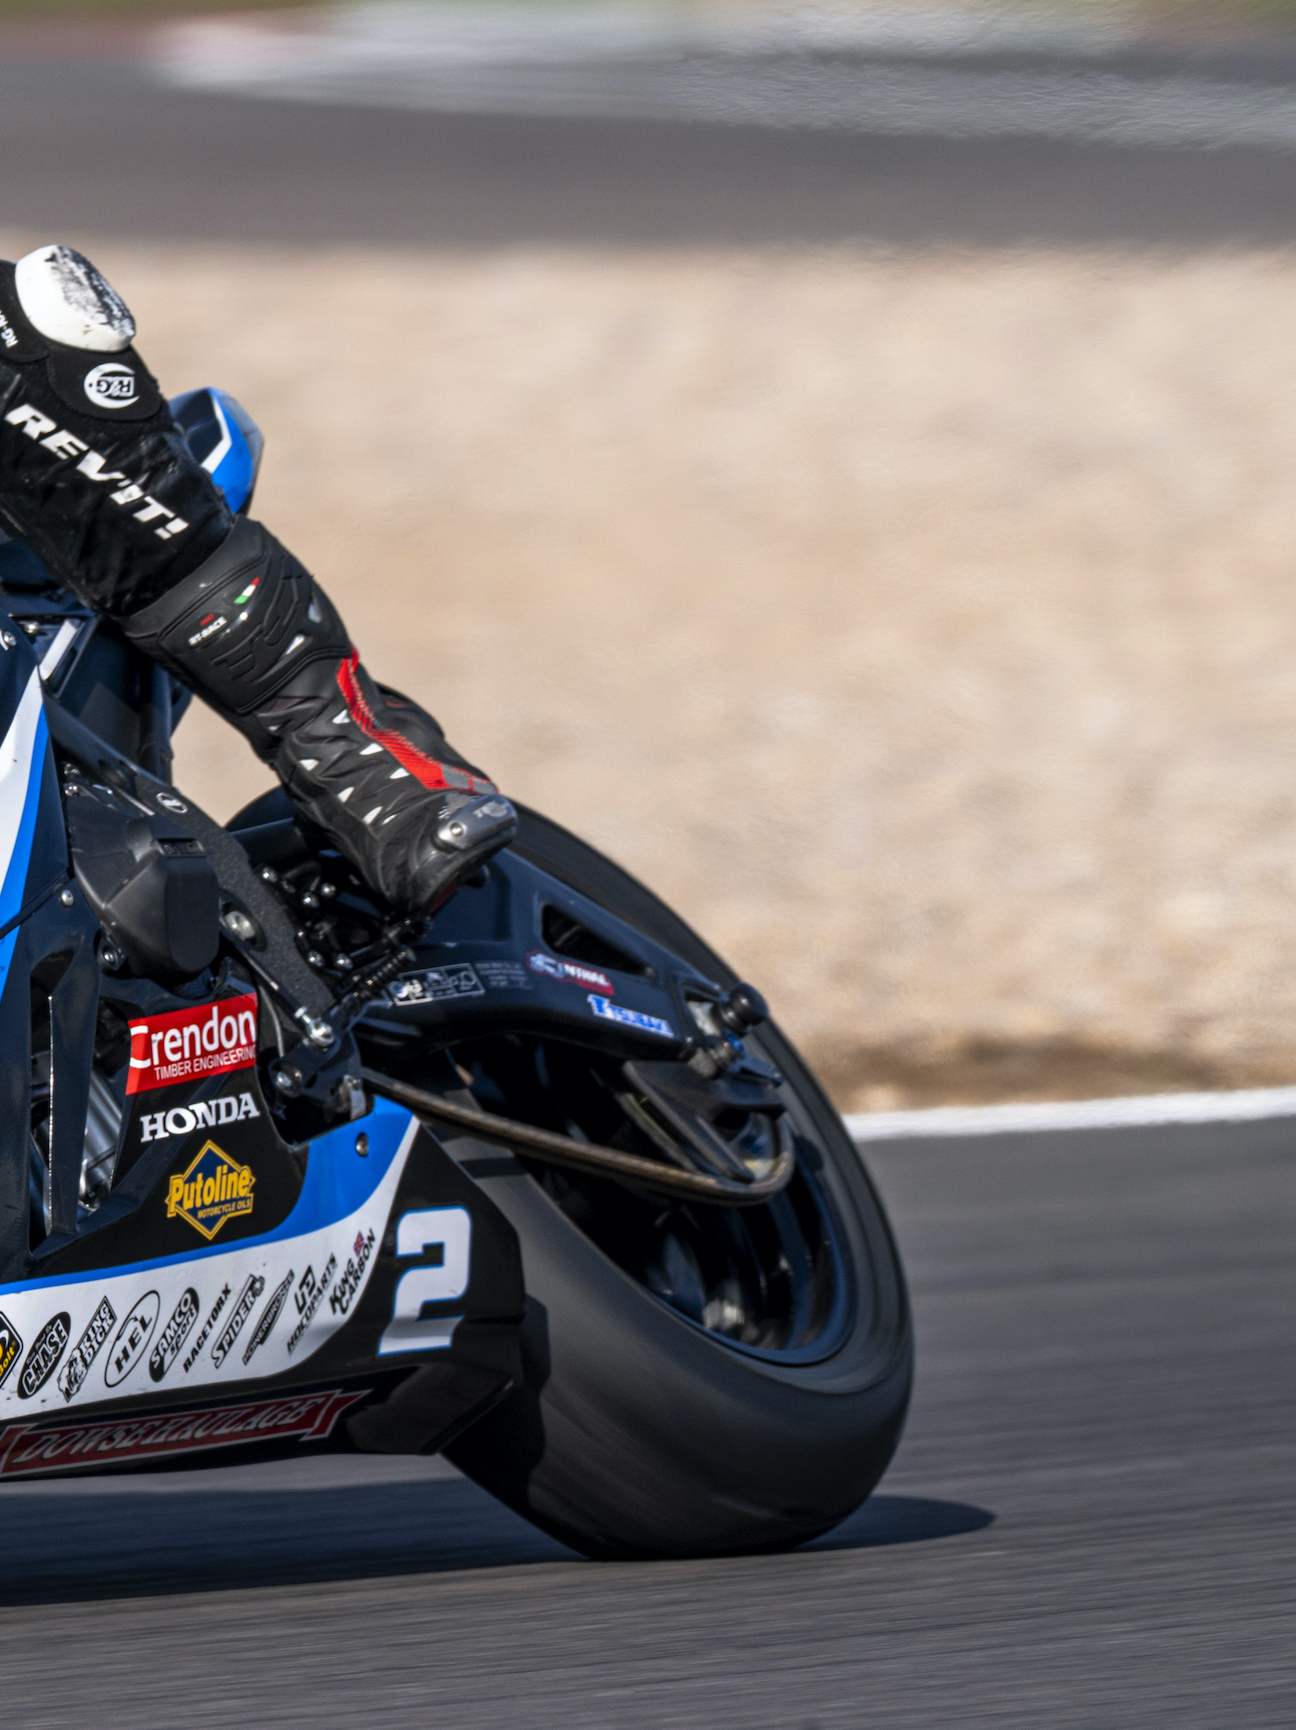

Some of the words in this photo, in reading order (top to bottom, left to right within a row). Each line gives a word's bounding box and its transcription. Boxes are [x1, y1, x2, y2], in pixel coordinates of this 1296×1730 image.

[130, 1005, 257, 1069] Crendon
[154, 1058, 193, 1081] TIMBER
[140, 1092, 261, 1144] HONDA
[168, 1163, 253, 1213] Putoline
[197, 1203, 236, 1220] MOTORCYCLE
[236, 1199, 252, 1212] OILS
[328, 1258, 356, 1317] KING
[340, 1228, 377, 1316] CARBON
[379, 1205, 472, 1357] 2
[79, 1303, 110, 1352] KING
[150, 1291, 192, 1370] SAMCO
[169, 1306, 196, 1358] sport
[182, 1283, 232, 1374] RACETORX
[212, 1290, 257, 1370] SPIDER
[287, 1252, 338, 1354] HOCOPARTS
[22, 1319, 69, 1396] CHASE
[84, 1316, 116, 1366] DICK
[114, 1315, 153, 1375] HEL
